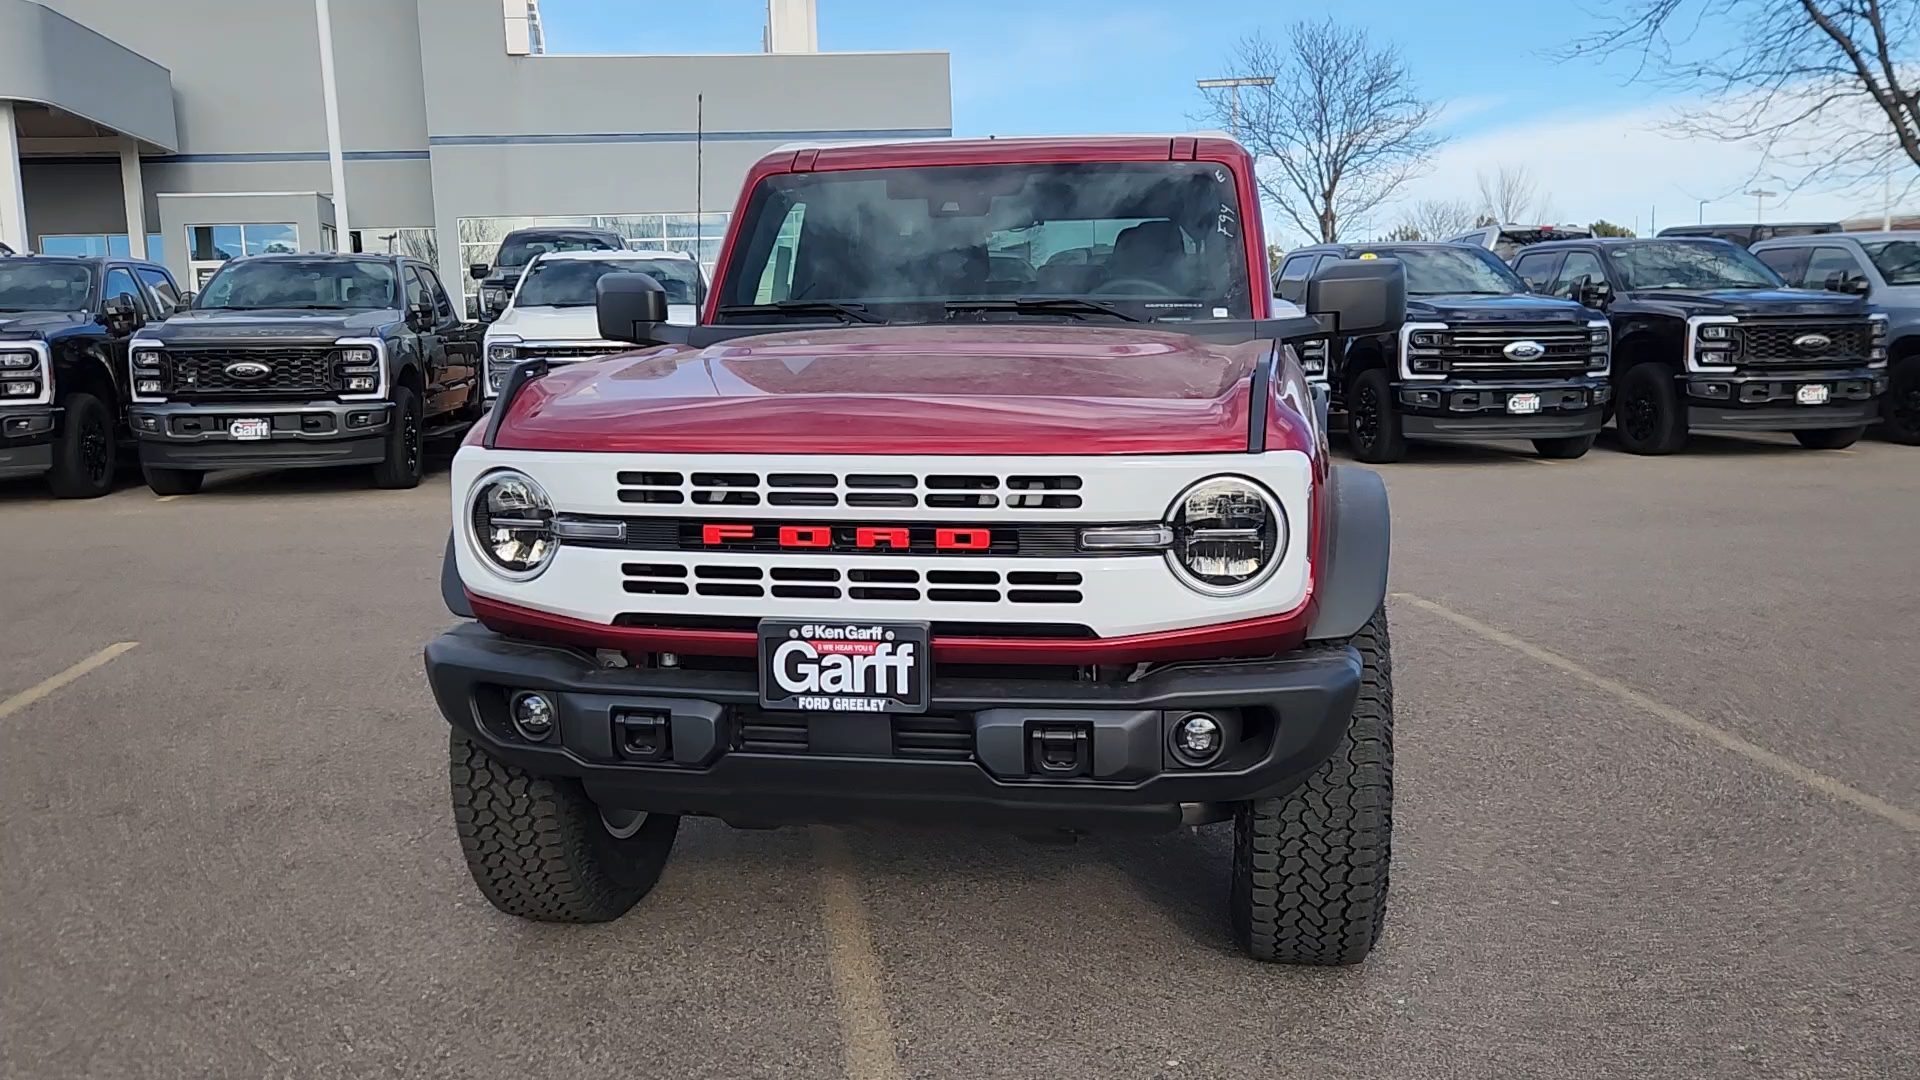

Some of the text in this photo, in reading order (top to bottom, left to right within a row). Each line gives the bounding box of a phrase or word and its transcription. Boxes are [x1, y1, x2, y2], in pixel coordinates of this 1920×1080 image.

[1508, 396, 1540, 411] Garff
[230, 422, 268, 437] Garff
[703, 524, 991, 549] FORD
[815, 625, 844, 639] Ken
[845, 626, 883, 640] Garff
[835, 644, 852, 652] HEAR
[773, 640, 914, 695] Garff
[798, 697, 886, 712] FORD GREELEY
